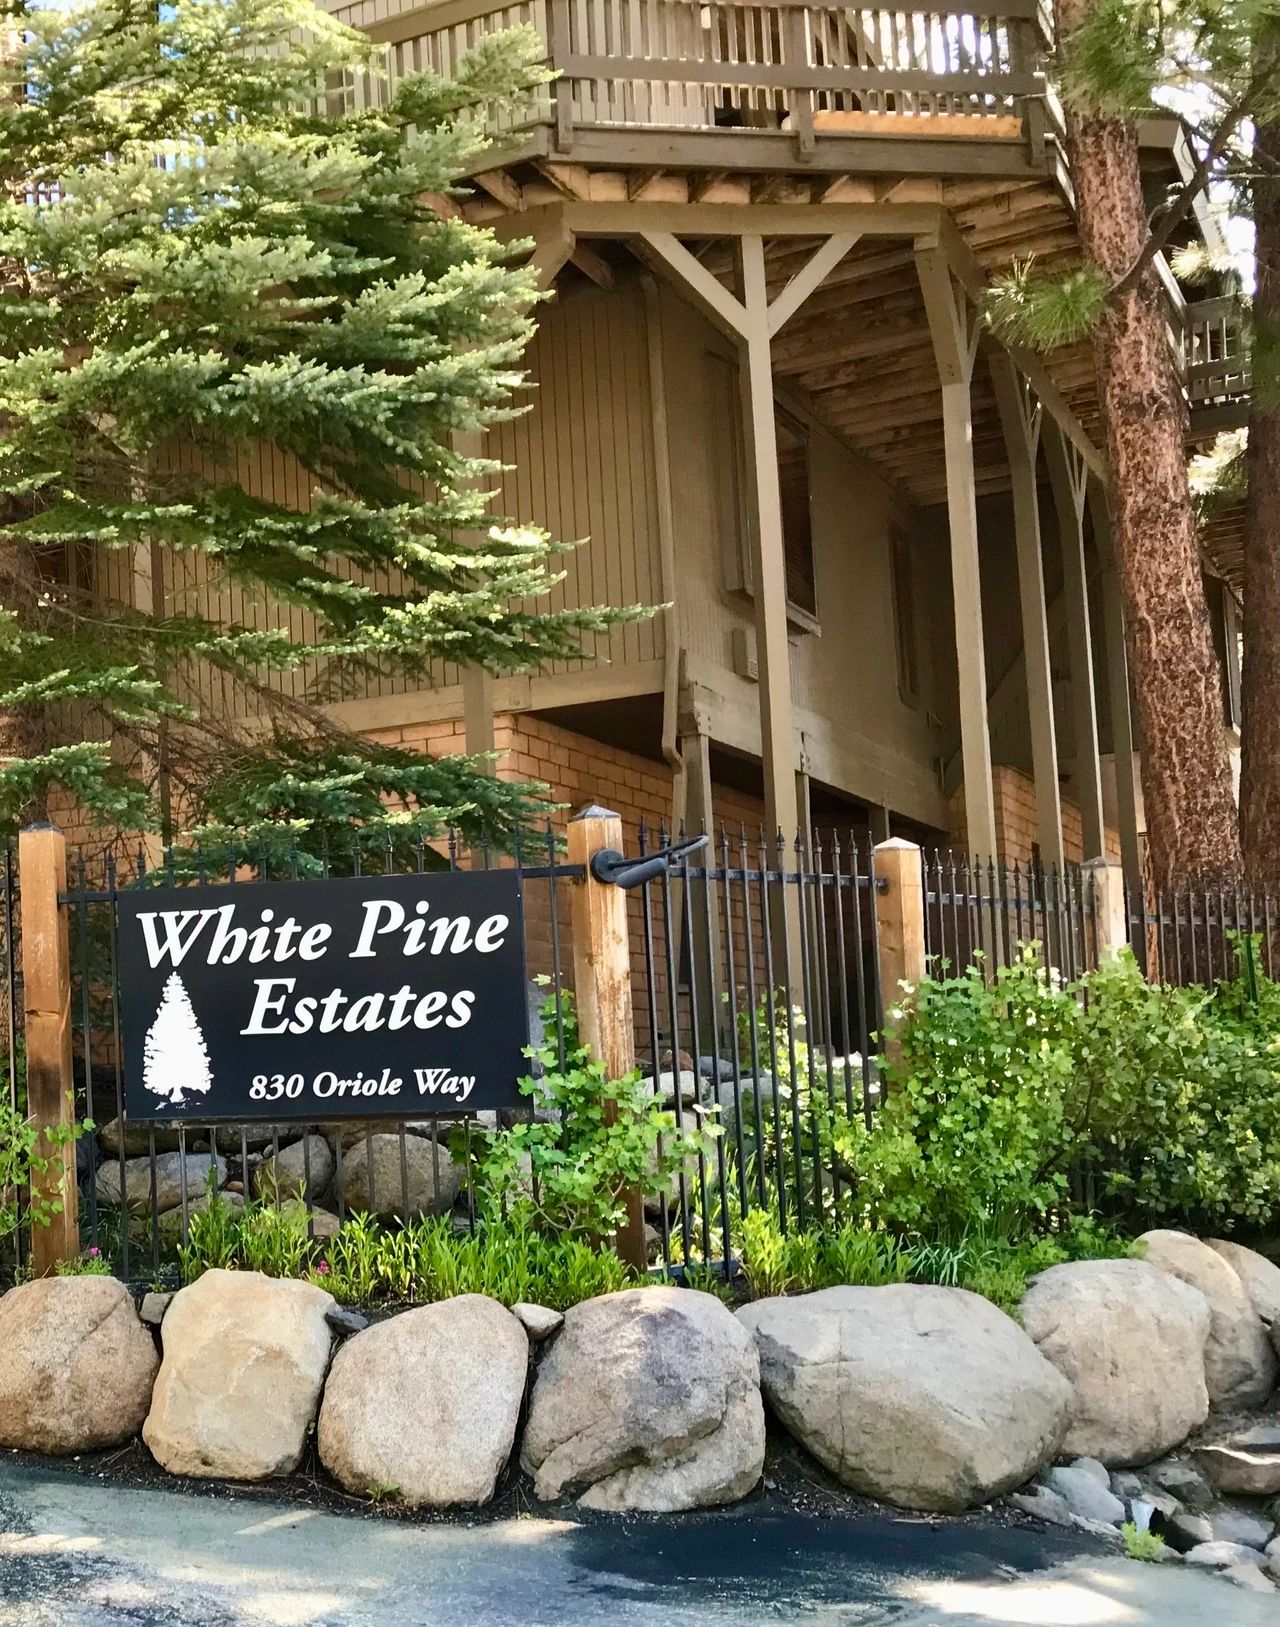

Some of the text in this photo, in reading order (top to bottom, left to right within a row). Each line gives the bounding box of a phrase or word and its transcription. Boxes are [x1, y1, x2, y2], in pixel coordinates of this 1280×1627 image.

[135, 899, 510, 969] White Pine
[239, 977, 477, 1036] Estates
[248, 1068, 476, 1102] 830 Oriole Way
